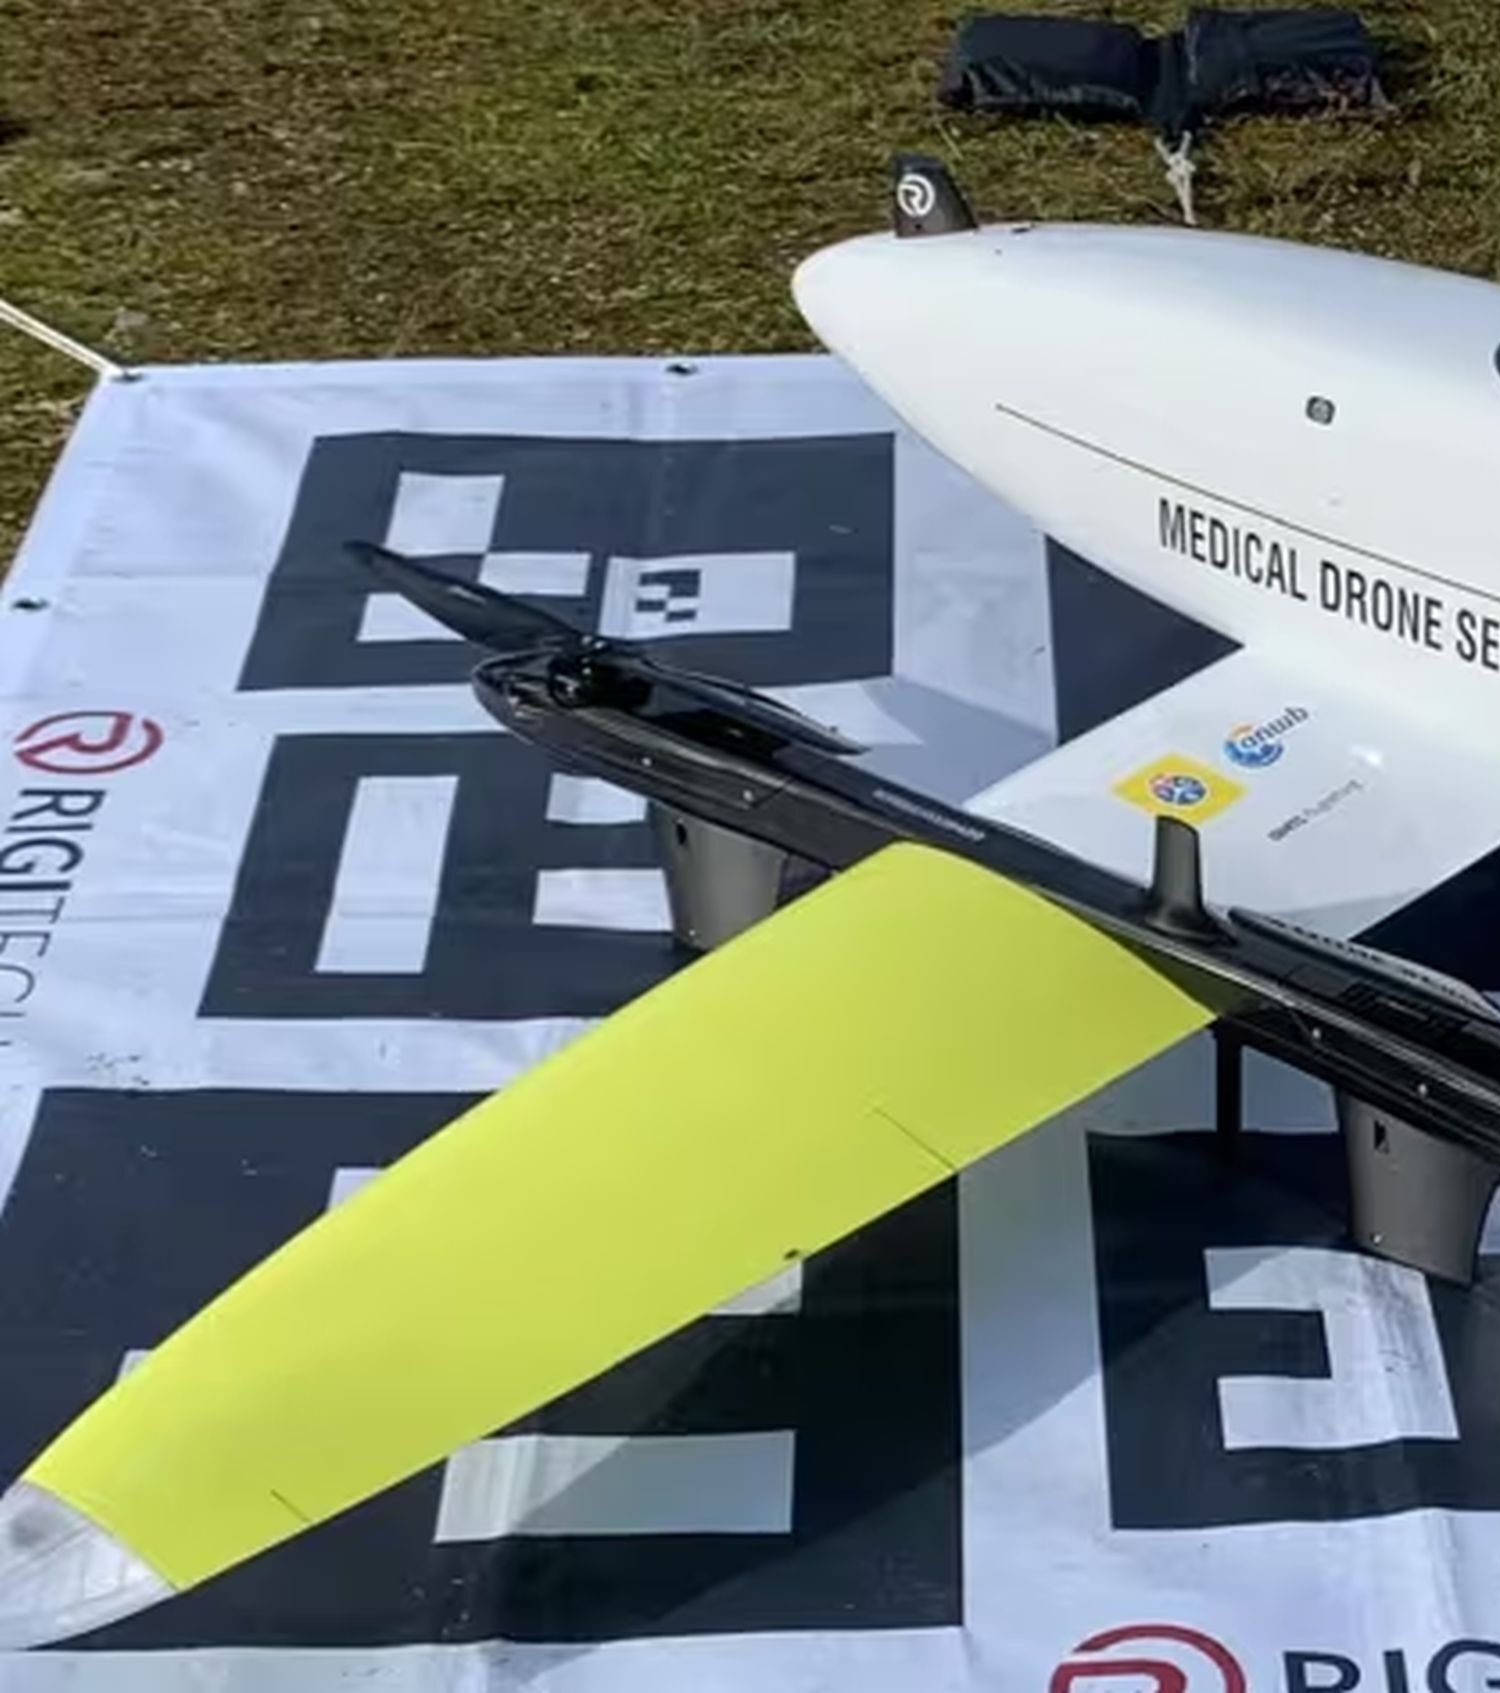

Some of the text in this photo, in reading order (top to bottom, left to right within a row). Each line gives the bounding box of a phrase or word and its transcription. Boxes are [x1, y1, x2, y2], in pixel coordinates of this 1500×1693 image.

[1158, 497, 1308, 602] MEDICAL
[1320, 561, 1443, 652] DRONE
[1240, 706, 1308, 749] anwb
[0, 788, 107, 1047] RIGITE
